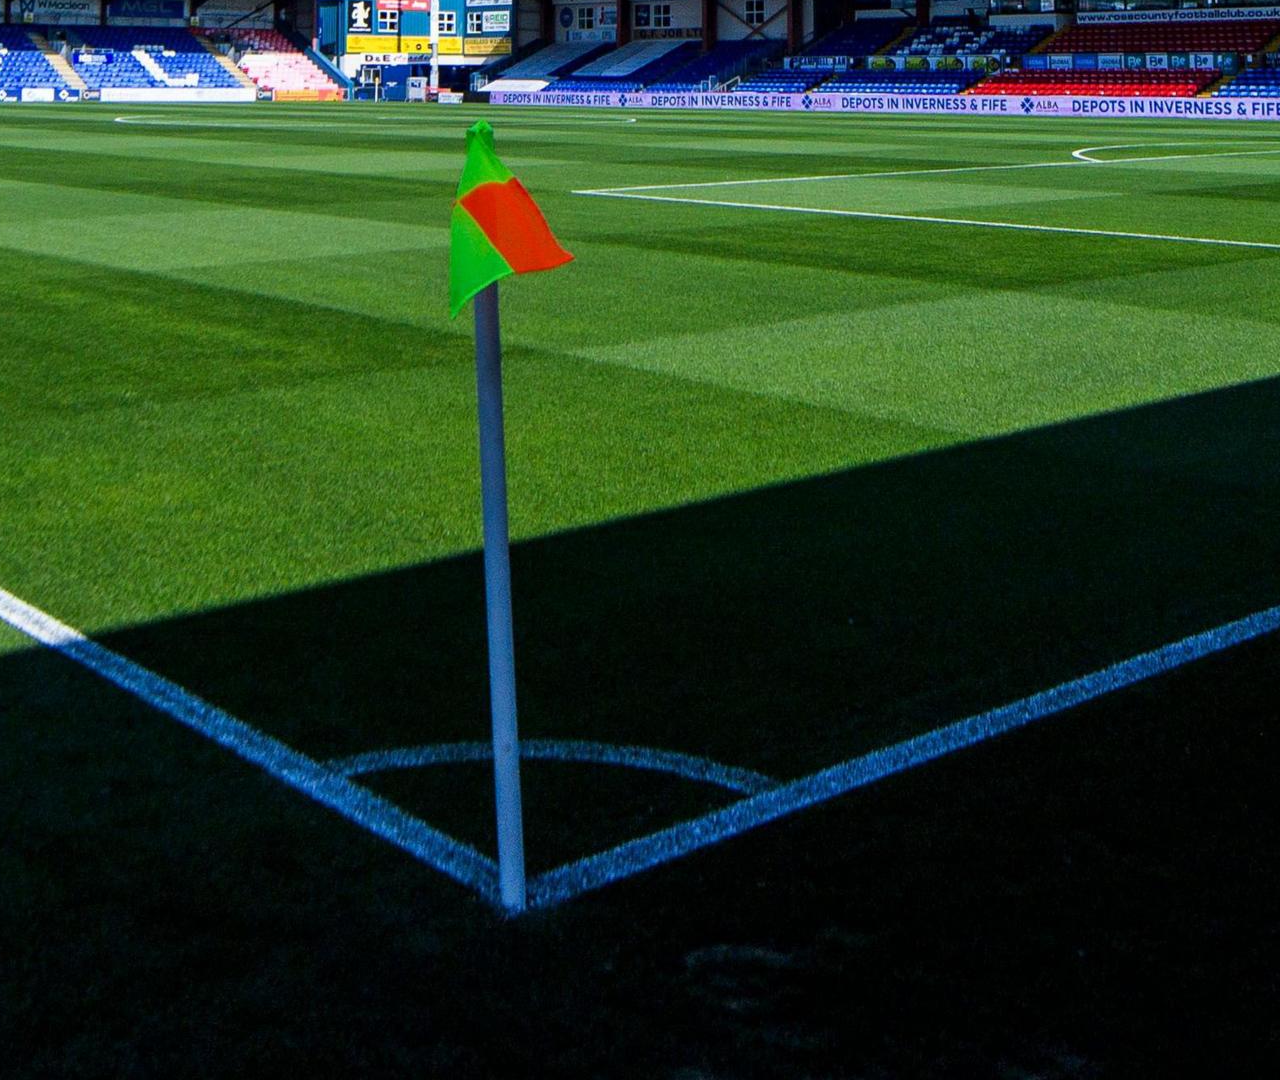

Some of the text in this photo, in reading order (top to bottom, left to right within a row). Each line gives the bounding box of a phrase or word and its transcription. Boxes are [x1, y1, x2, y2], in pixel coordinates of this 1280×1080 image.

[121, 0, 173, 13] MGL
[503, 94, 531, 103] DEPOTS
[533, 94, 541, 103] IN
[543, 95, 585, 105] INVERNESS
[586, 95, 591, 104] &
[593, 95, 610, 105] FIFE
[651, 96, 791, 108] DEPOTS IN INVERNESS & FIFE
[842, 97, 1007, 111] DEPOTS IN INVERNESS & FIFE
[1072, 100, 1125, 113] DEPOTS
[1130, 101, 1144, 113] IN
[1150, 101, 1232, 115] INVERNESS
[1237, 102, 1247, 115] &
